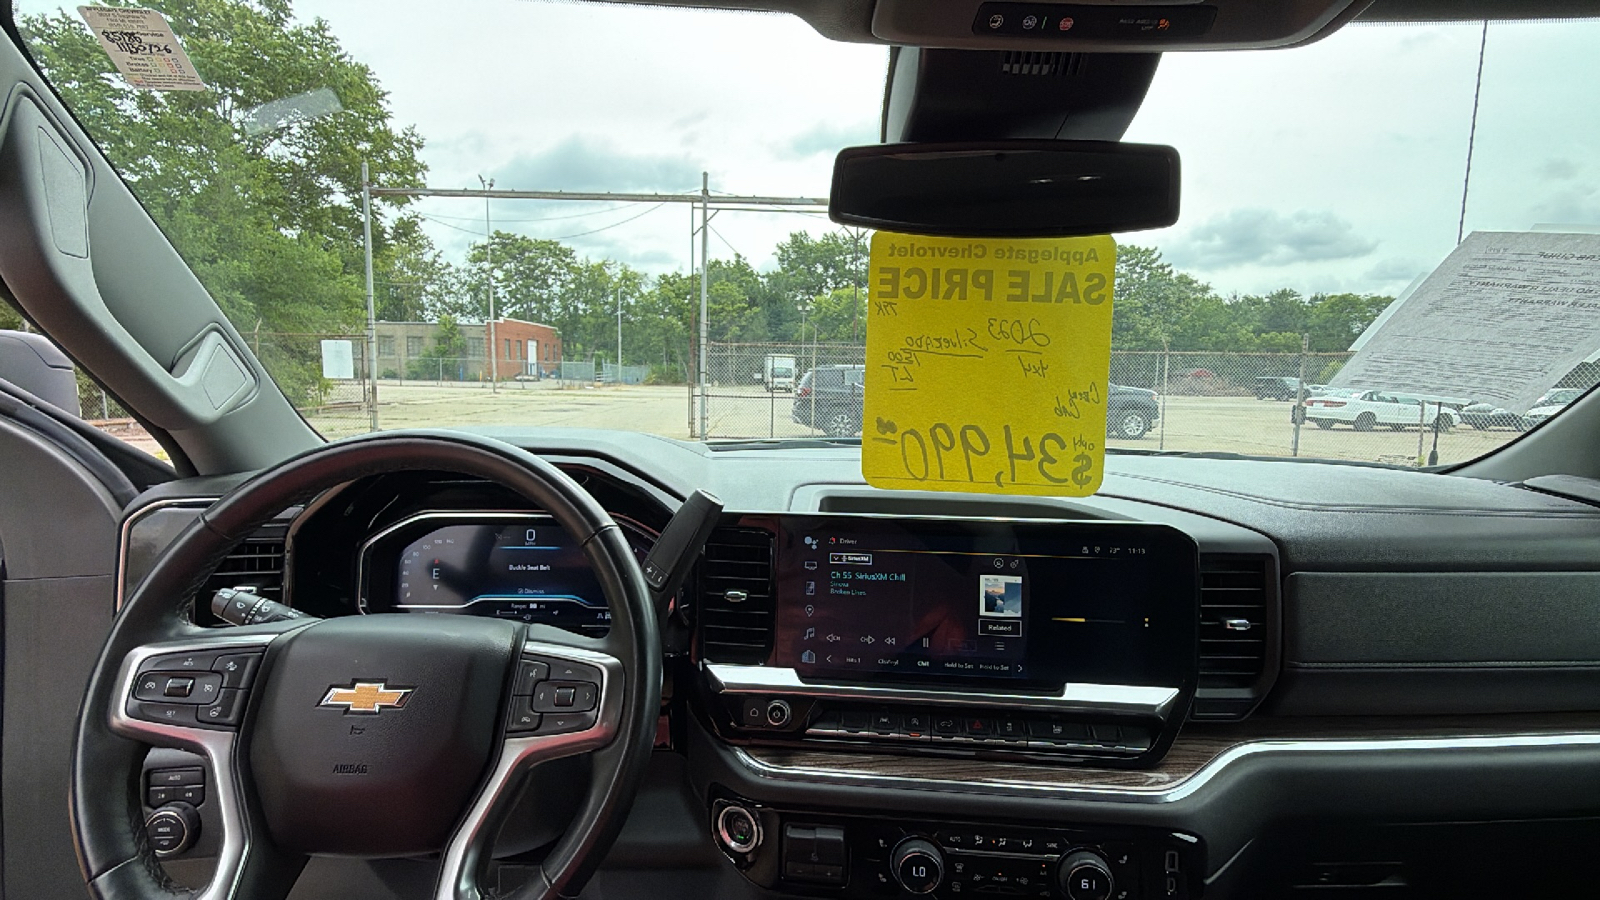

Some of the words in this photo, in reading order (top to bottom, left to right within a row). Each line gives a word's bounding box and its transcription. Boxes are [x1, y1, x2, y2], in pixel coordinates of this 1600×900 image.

[432, 568, 440, 579] E
[830, 571, 841, 579] Ch
[842, 571, 852, 579] 55
[855, 572, 887, 580] SiriusXM
[889, 573, 906, 581] Chill
[988, 624, 1012, 632] Related
[332, 764, 367, 774] AIRBAG
